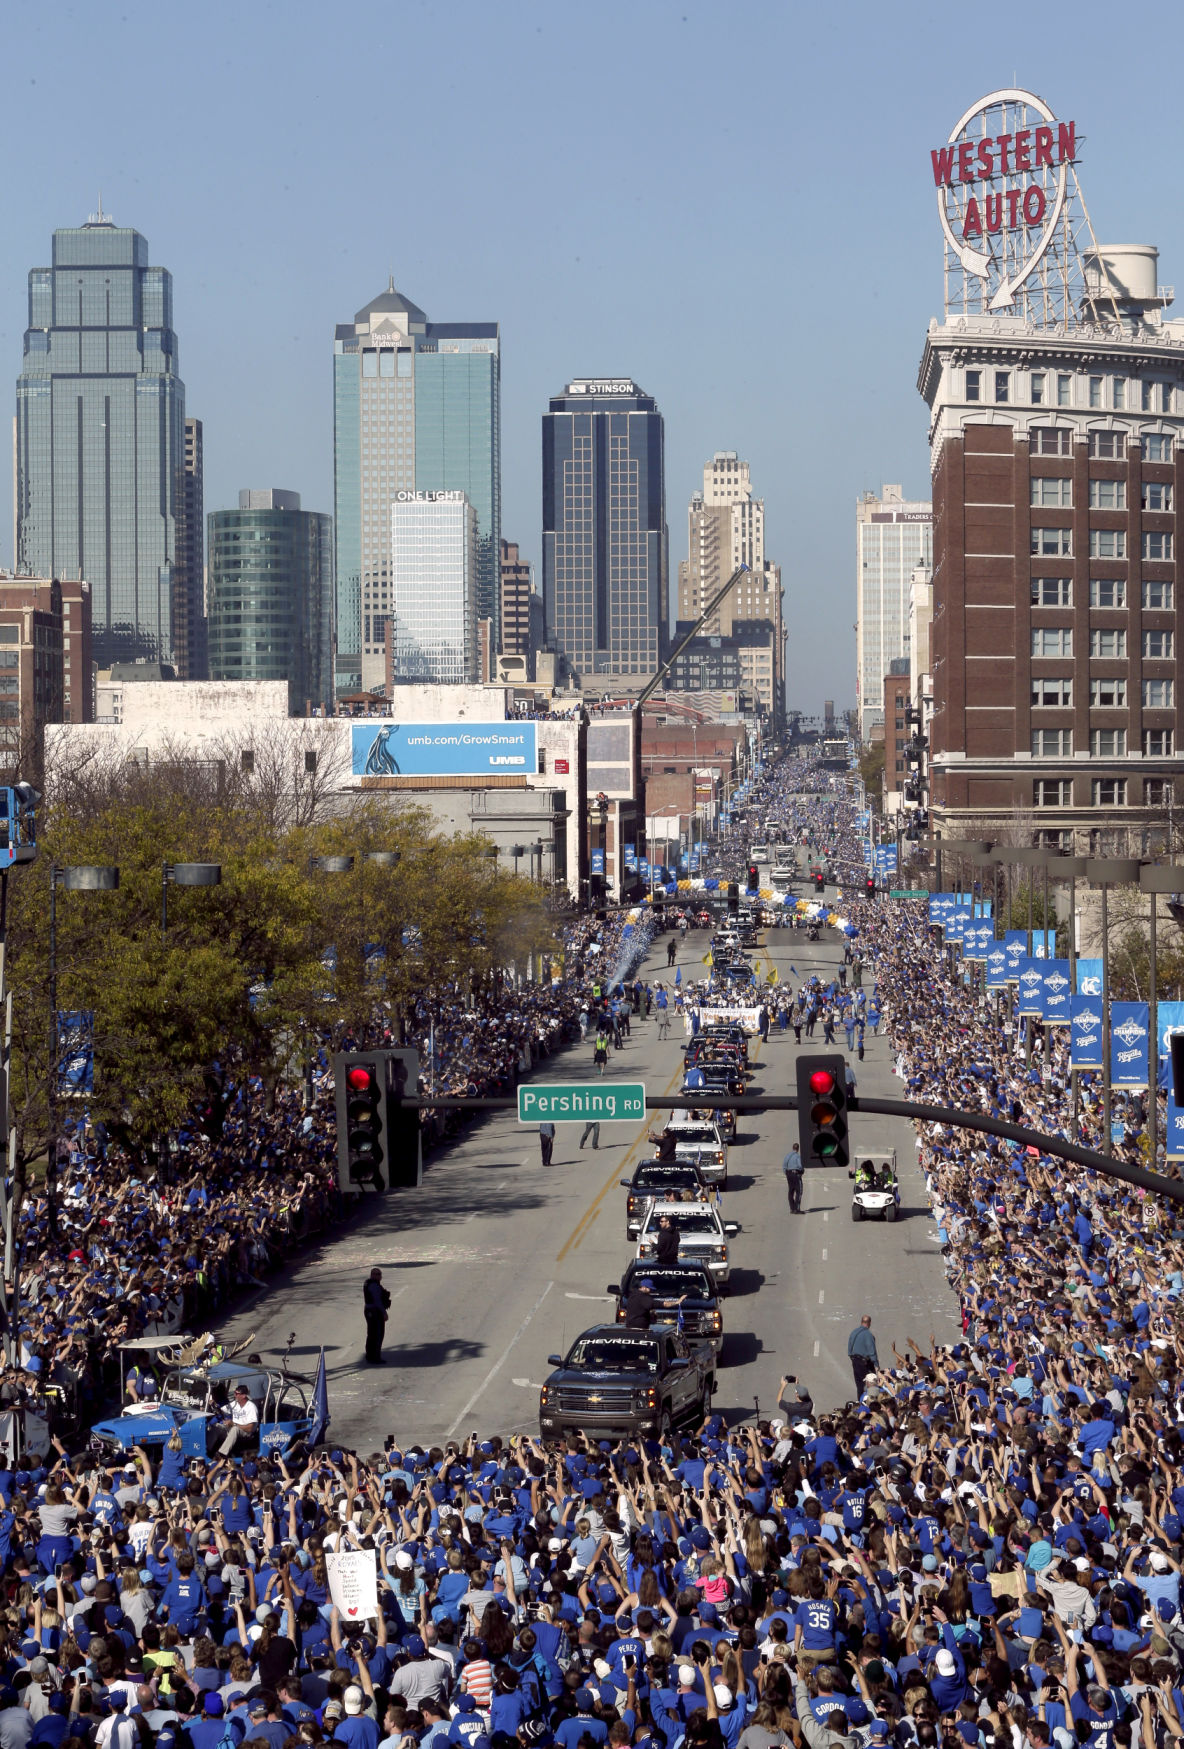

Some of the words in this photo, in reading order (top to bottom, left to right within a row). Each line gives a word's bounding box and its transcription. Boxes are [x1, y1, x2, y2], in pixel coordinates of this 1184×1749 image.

[930, 120, 1076, 187] WESTERN
[962, 184, 1046, 238] AUTO
[371, 332, 392, 340] Bank
[371, 339, 402, 348] Midwest
[589, 384, 633, 393] STINSON
[397, 490, 424, 501] ONE
[425, 490, 461, 501] LIGHT
[407, 734, 525, 746] umb.com/GrowSmart
[489, 755, 526, 765] UMB
[1113, 1027, 1147, 1036] CHAMPIONS
[1117, 1048, 1143, 1063] Royals
[523, 1091, 617, 1117] Pershing
[624, 1099, 642, 1111] RD
[641, 1166, 695, 1174] CHEVROLET
[653, 1210, 713, 1218] CHEVROLET
[634, 1269, 704, 1278] CHEVROLET
[579, 1338, 658, 1347] CHEVROLET
[852, 1505, 863, 1519] 16
[807, 1602, 831, 1613] HOSMER
[808, 1611, 830, 1630] 35
[618, 1643, 638, 1654] PEREZ
[815, 1702, 846, 1717] GORDON
[1094, 1731, 1108, 1749] 4
